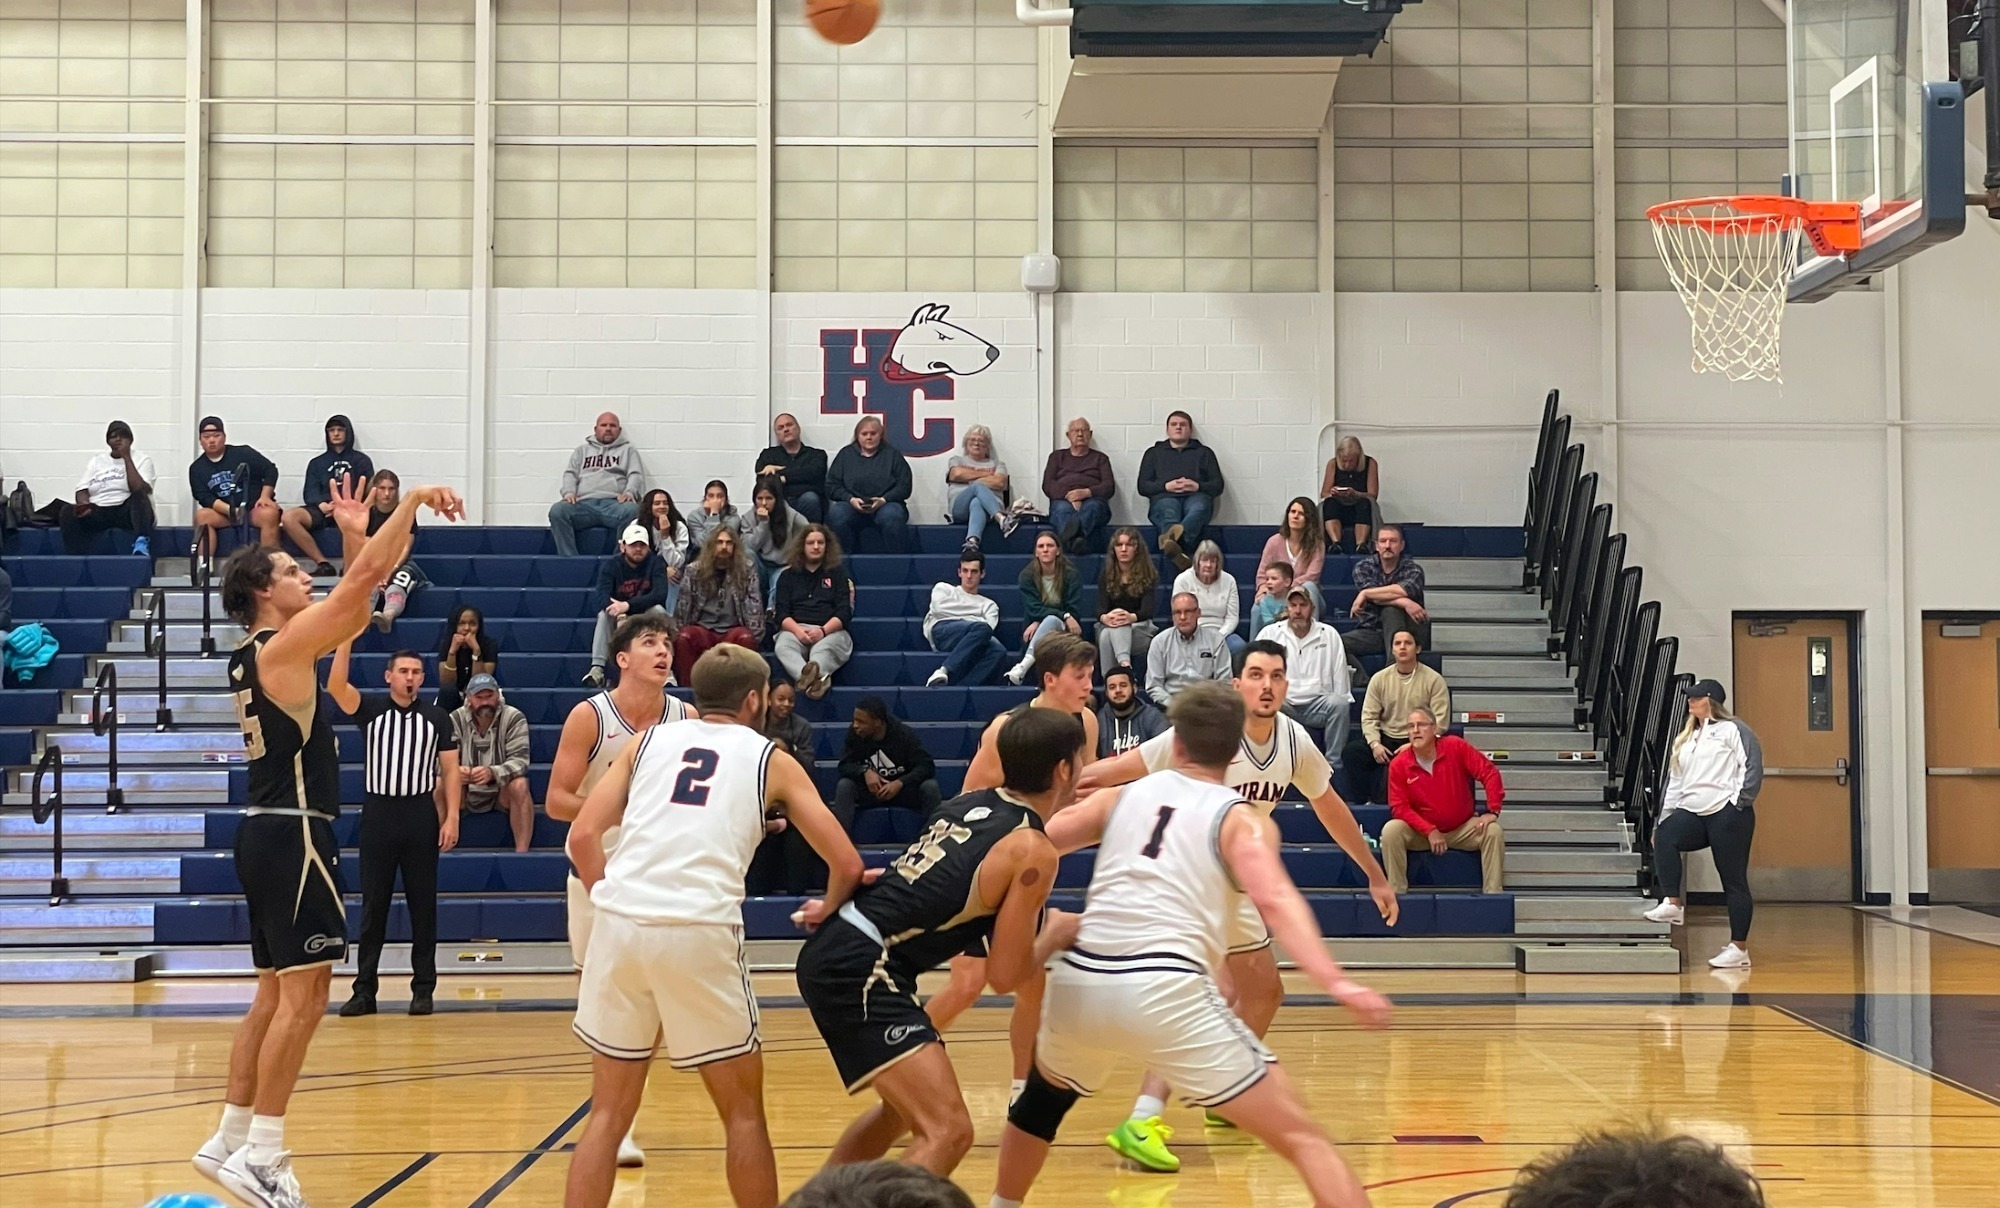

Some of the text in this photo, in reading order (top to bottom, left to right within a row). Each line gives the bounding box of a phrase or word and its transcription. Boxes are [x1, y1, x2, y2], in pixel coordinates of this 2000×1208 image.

[583, 454, 620, 469] HIRAM
[1113, 734, 1140, 751] nike
[670, 747, 720, 807] 2
[1139, 805, 1177, 860] 1
